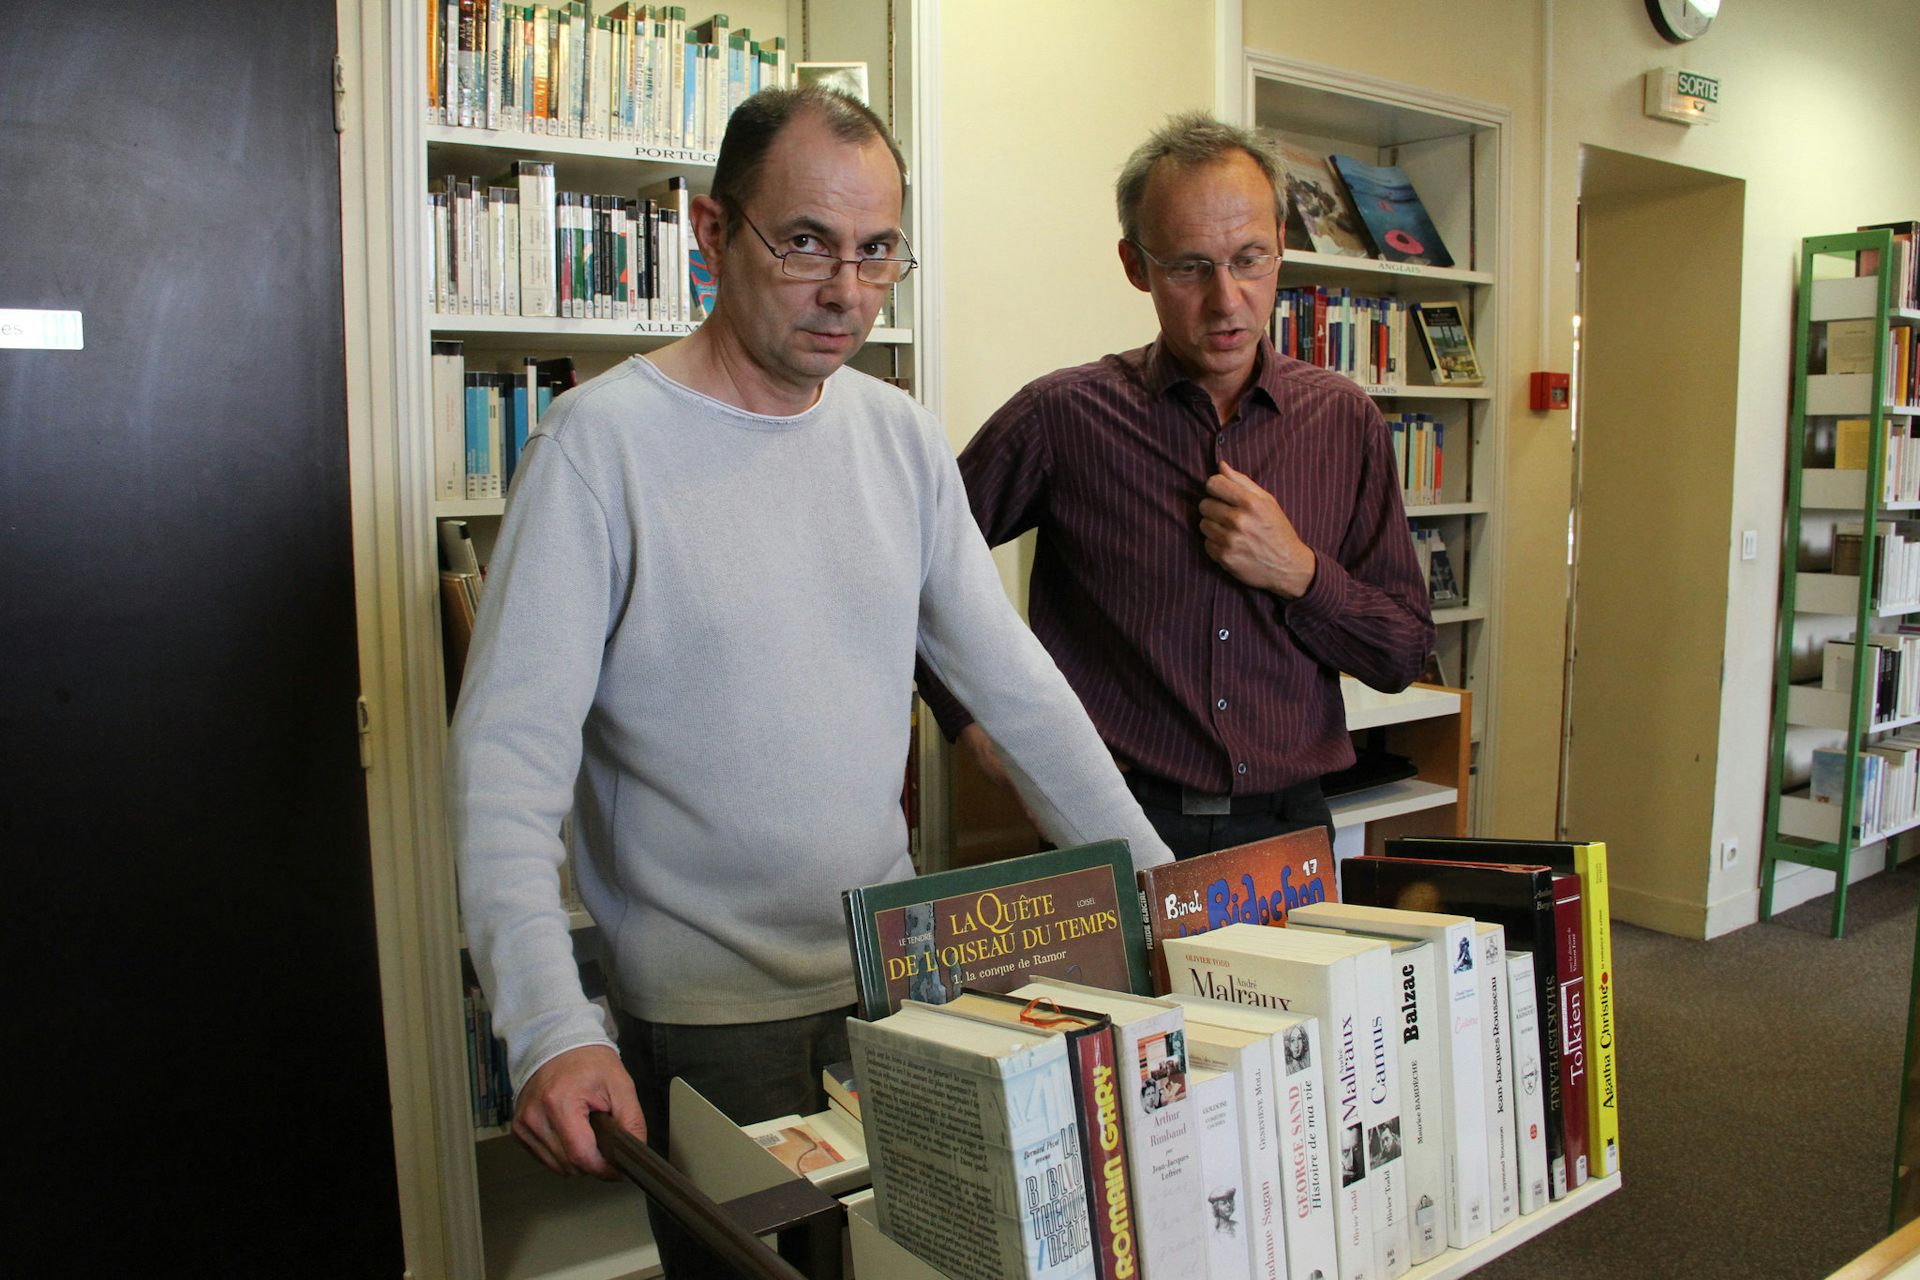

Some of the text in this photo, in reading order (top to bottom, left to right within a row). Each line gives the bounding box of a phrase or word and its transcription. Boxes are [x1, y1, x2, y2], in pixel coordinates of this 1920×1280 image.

[1378, 262, 1421, 273] ANGLAIS
[1302, 858, 1318, 877] 17
[1076, 897, 1096, 908] LOISEL
[1164, 889, 1203, 920] Binet
[1206, 865, 1325, 931] Bidochon
[888, 909, 1118, 980] DE L'OISEAU DU TEMPS
[950, 912, 977, 936] LA
[966, 970, 976, 982] la
[979, 962, 1016, 977] conque
[1018, 956, 1031, 969] de
[1034, 950, 1067, 966] Ramor
[1236, 977, 1258, 988] André
[1188, 967, 1293, 1012] Malraux
[1401, 964, 1420, 1044] Balzac
[1491, 976, 1500, 1037] Rousseau
[1371, 1015, 1388, 1106] Camus
[1546, 976, 1558, 1111] SHAKESPEARE
[1570, 992, 1584, 1086] Tolkien
[1599, 983, 1615, 1109] Agatha Christie
[1340, 1015, 1359, 1123] Malraux
[1060, 1122, 1079, 1159] LA
[1150, 1122, 1187, 1147] Rimbaud
[1153, 1111, 1180, 1128] Arthur
[1416, 1110, 1424, 1144] Maurice
[1289, 1085, 1310, 1219] GEORGE SAND
[1304, 1079, 1322, 1209] Histoire de ma vie
[1092, 1065, 1135, 1280] ROMAIN GARY
[1261, 1180, 1272, 1226] Sagan
